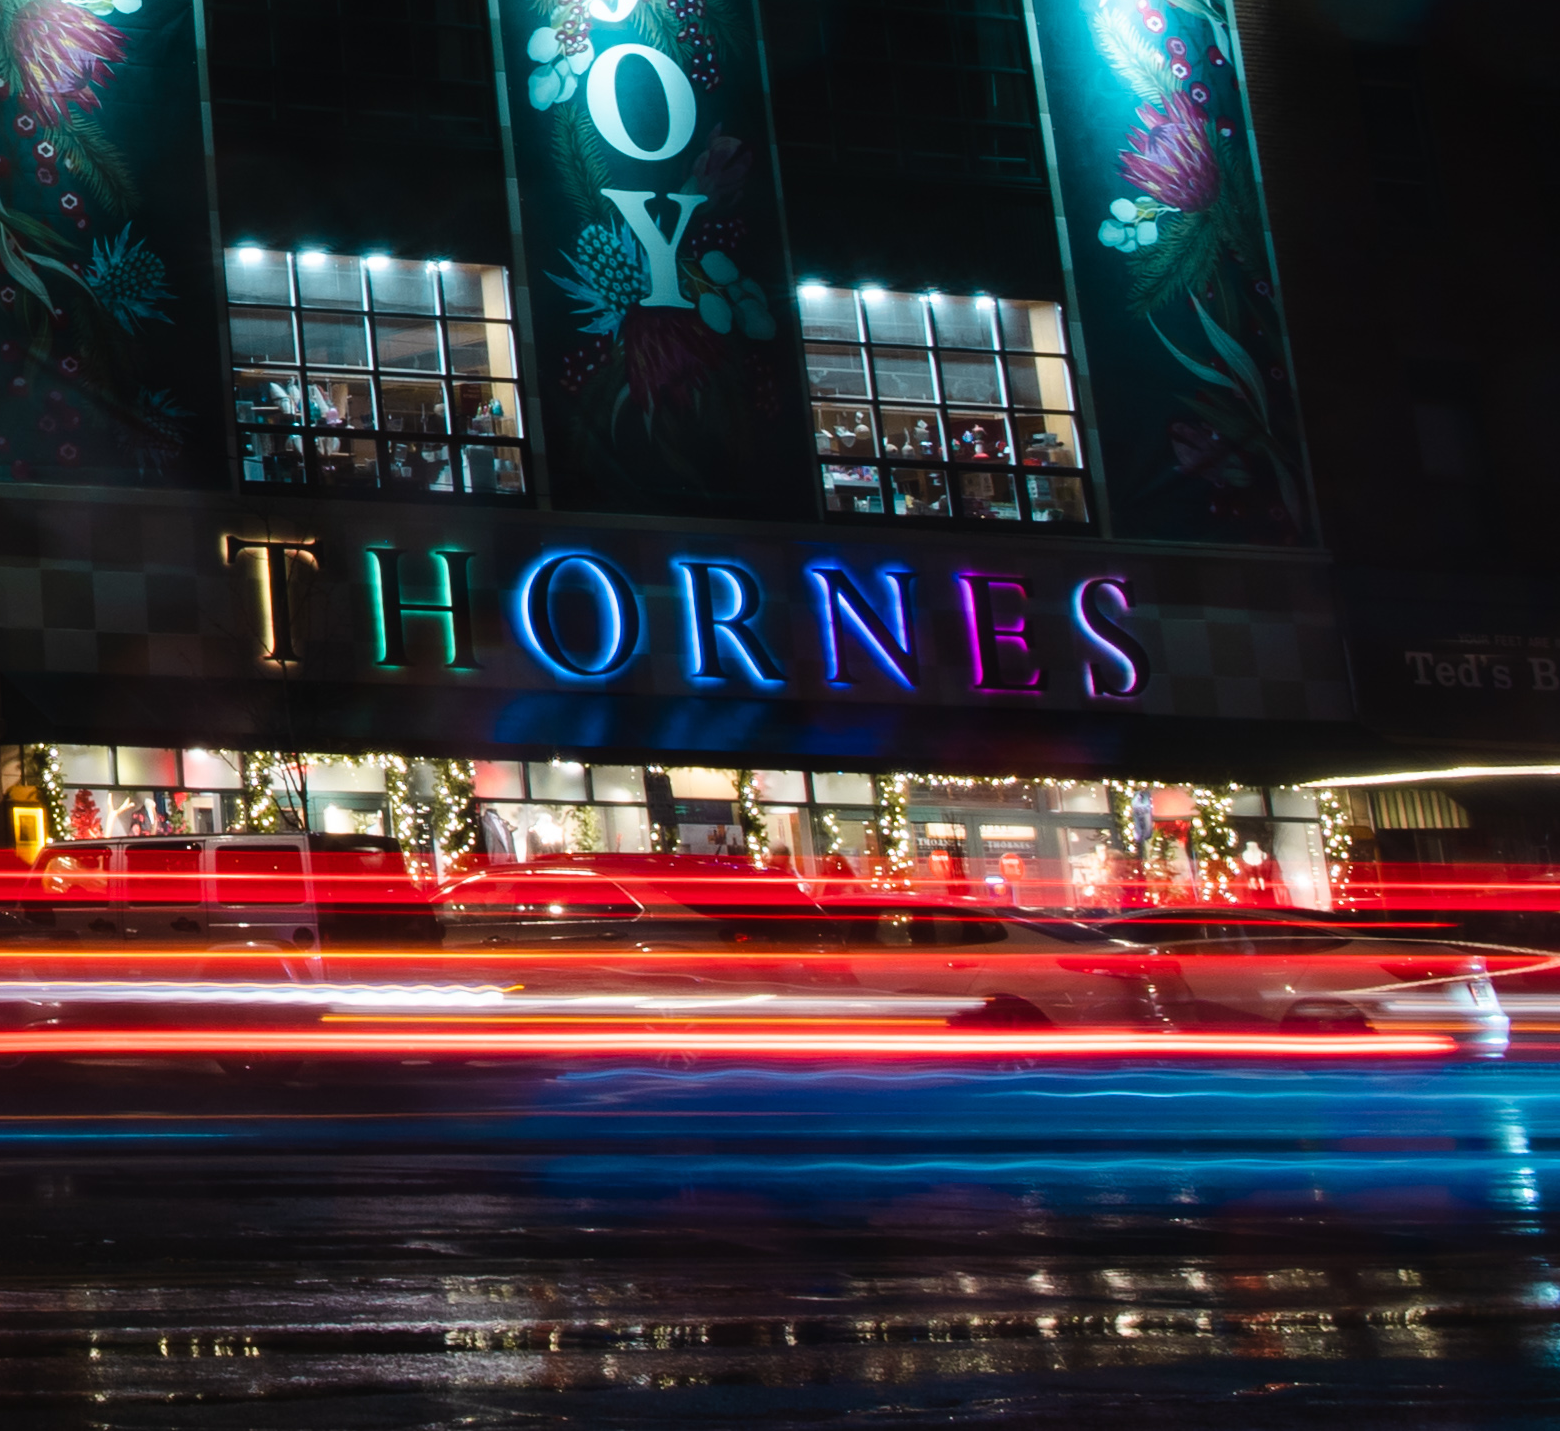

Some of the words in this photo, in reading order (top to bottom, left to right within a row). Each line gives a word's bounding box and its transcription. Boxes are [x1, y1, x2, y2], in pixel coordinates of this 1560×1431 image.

[223, 535, 1152, 698] THORNES
[1495, 634, 1521, 647] FEET
[1528, 636, 1550, 648] ARE
[1404, 651, 1513, 689] Ted's
